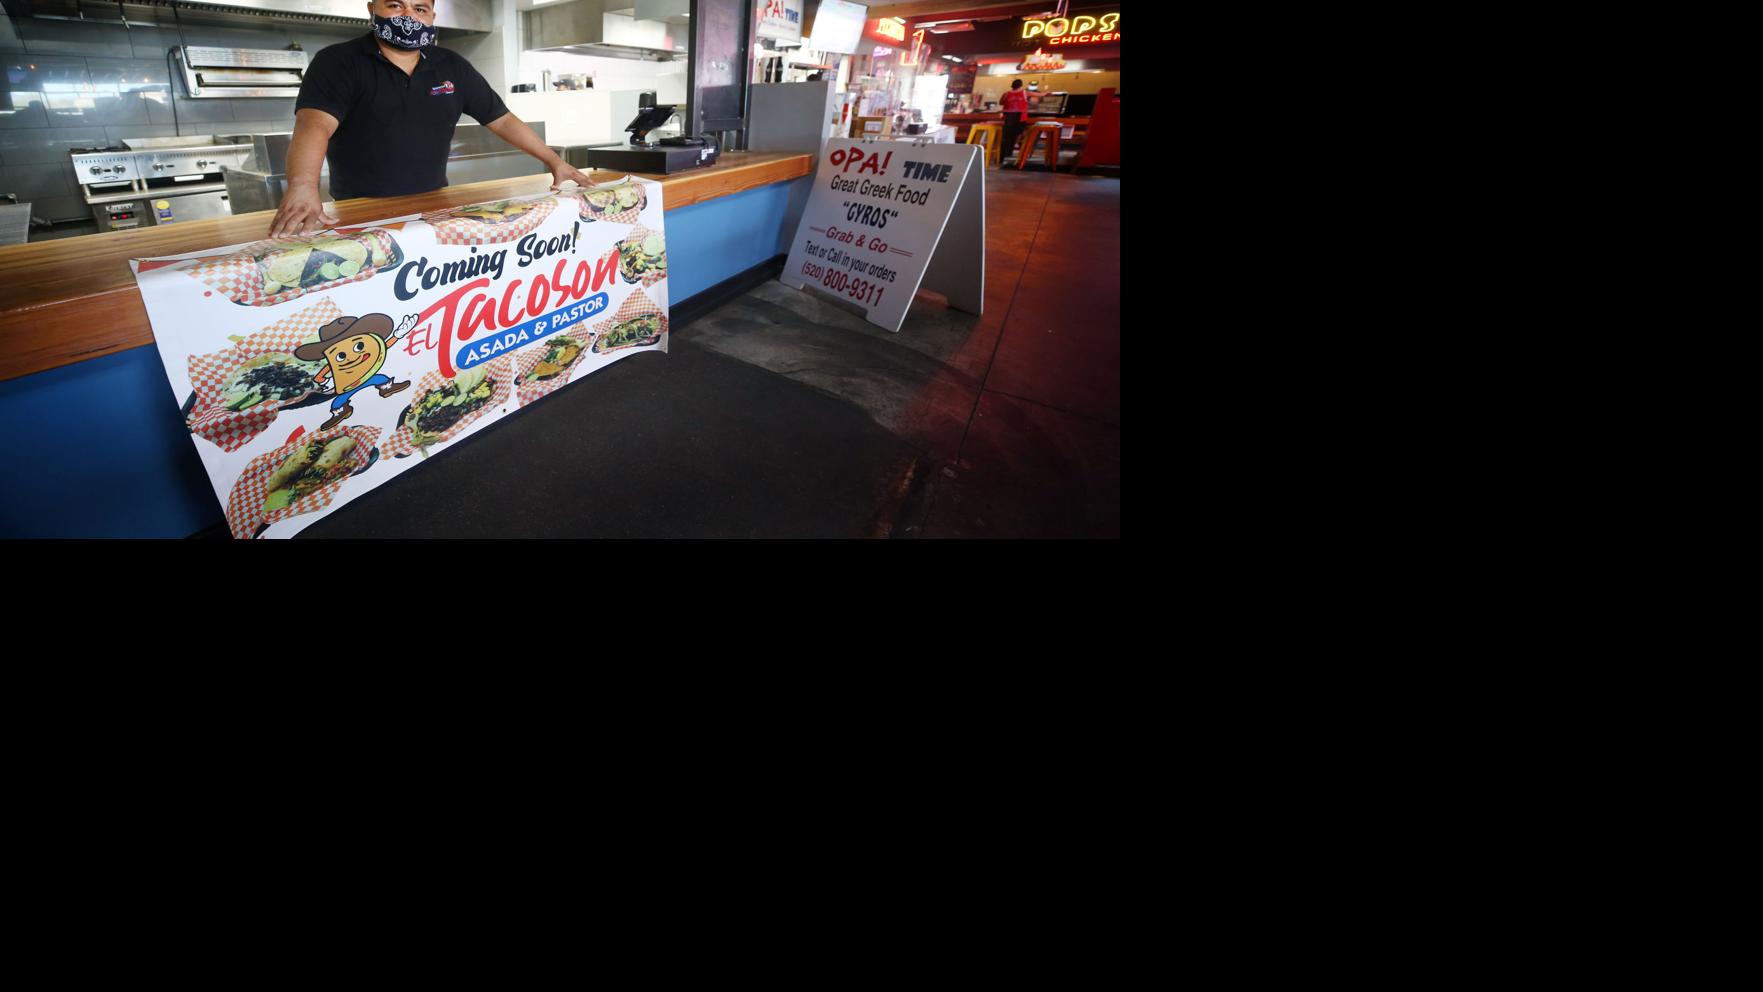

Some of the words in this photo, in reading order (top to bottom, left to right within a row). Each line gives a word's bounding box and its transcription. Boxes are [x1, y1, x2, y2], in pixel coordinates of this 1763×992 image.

[1022, 13, 1120, 38] POPS
[830, 147, 893, 176] OPA!
[903, 161, 953, 183] TIME
[830, 175, 859, 193] Great
[860, 179, 894, 200] Greek
[895, 184, 931, 206] Food
[826, 226, 854, 245] Grab
[855, 236, 866, 248] &
[868, 238, 889, 254] Go
[393, 247, 508, 301] Coming
[516, 221, 580, 267] Soon!
[805, 241, 819, 255] Text
[819, 246, 827, 257] or
[827, 247, 841, 263] Call
[842, 254, 849, 265] in
[849, 258, 869, 273] your
[868, 262, 897, 283] orders
[802, 262, 824, 282] (520)
[823, 268, 884, 307] 800-9311
[464, 331, 530, 365] ASADA
[534, 319, 547, 336] &
[552, 297, 604, 329] PASTOR
